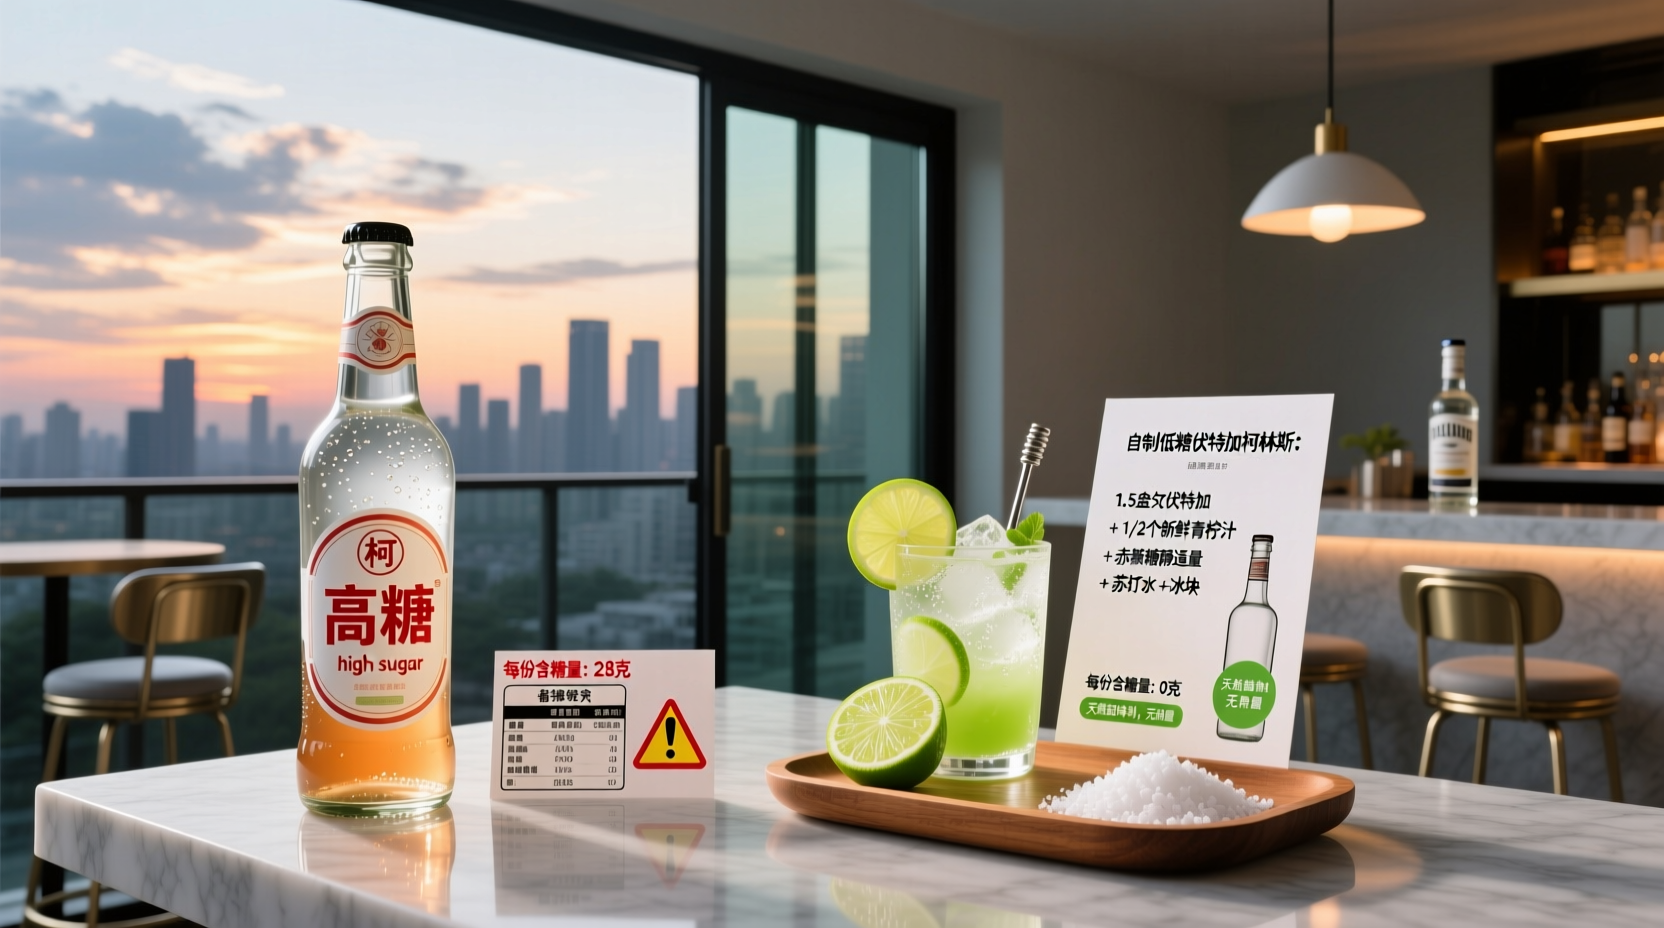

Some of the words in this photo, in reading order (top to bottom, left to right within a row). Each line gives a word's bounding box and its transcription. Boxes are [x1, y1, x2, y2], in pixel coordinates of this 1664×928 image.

[364, 536, 398, 569] 柯
[324, 583, 435, 647] 高糖
[337, 653, 374, 676] high
[378, 656, 424, 676] sugar
